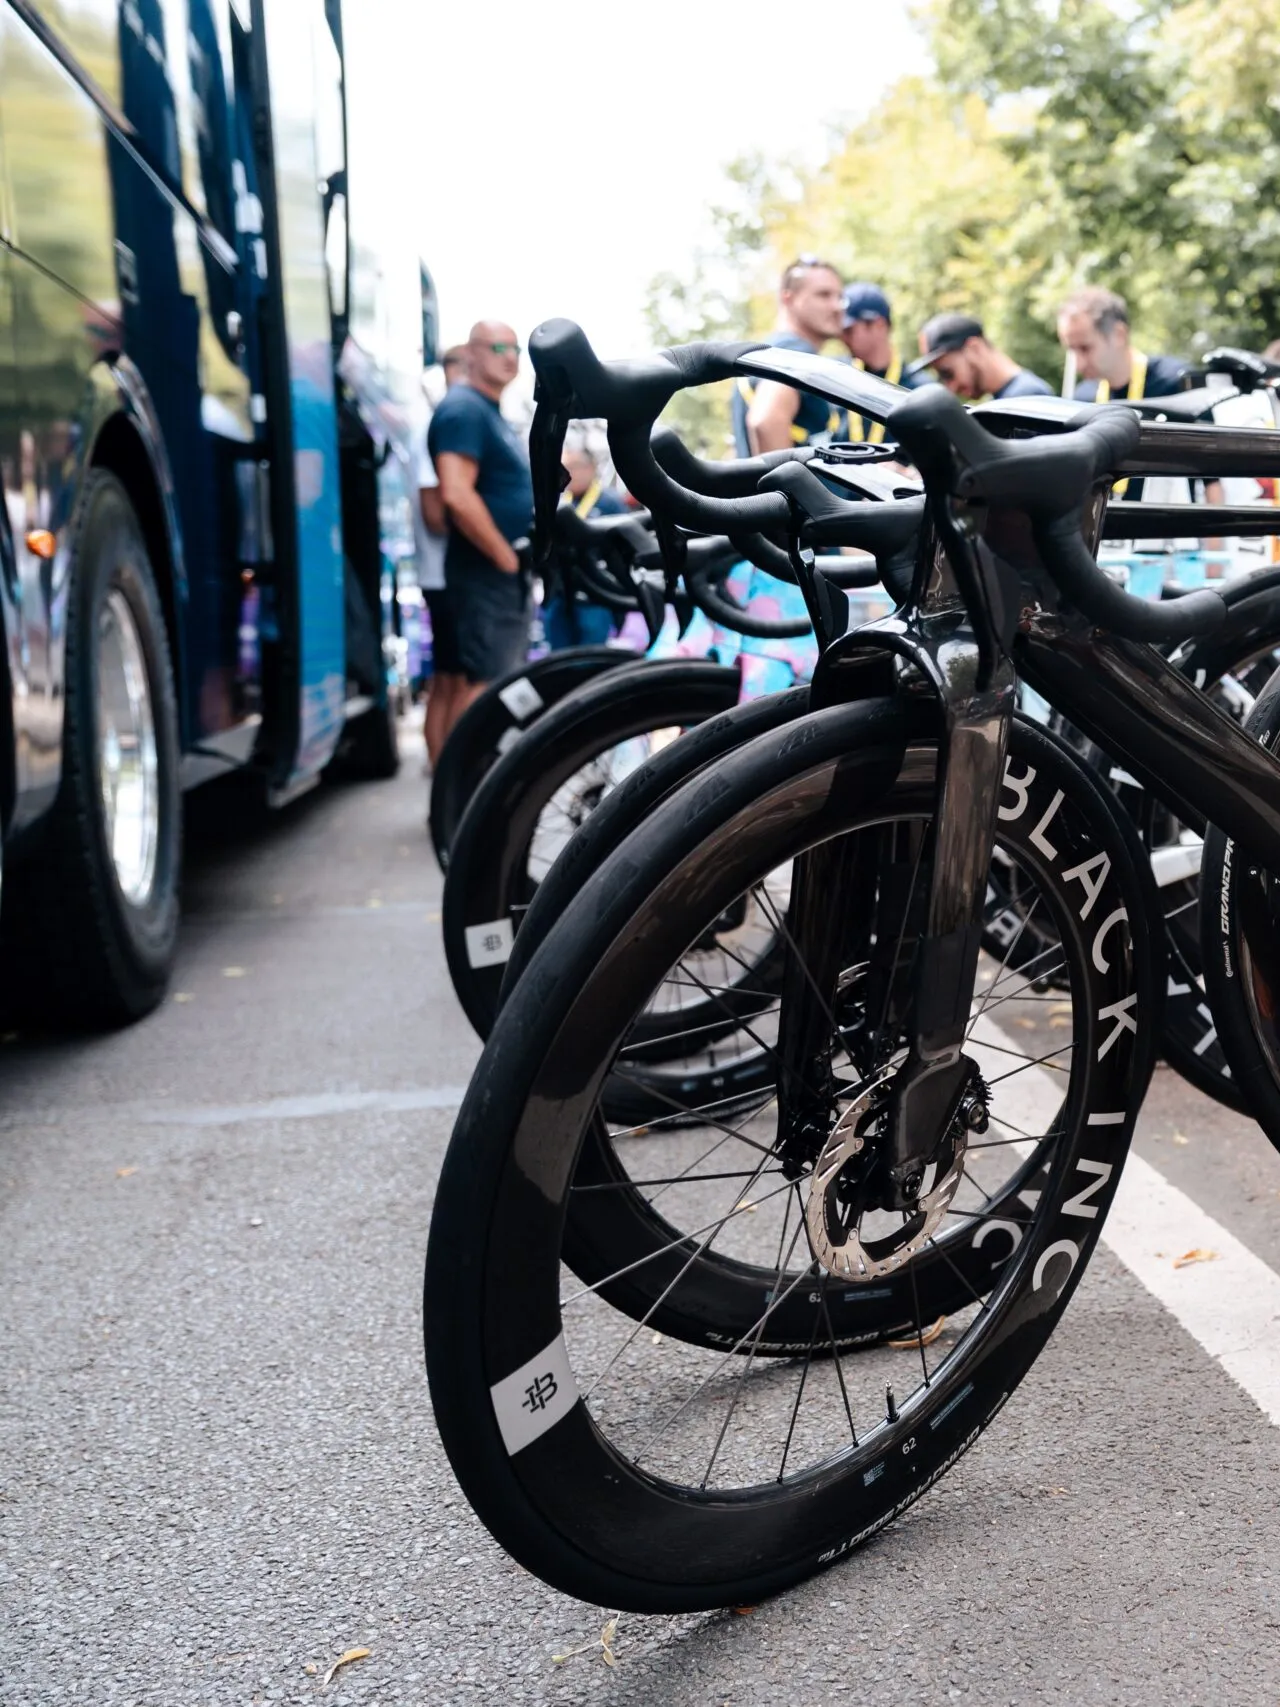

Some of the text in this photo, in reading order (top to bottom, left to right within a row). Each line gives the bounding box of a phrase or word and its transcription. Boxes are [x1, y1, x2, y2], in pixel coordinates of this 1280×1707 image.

[1224, 837, 1235, 867] PR
[998, 754, 1138, 1062] BLACK
[1221, 864, 1231, 935] GRAND
[1033, 1111, 1126, 1299] INC
[902, 1437, 917, 1455] 62
[849, 1507, 896, 1546] 5000
